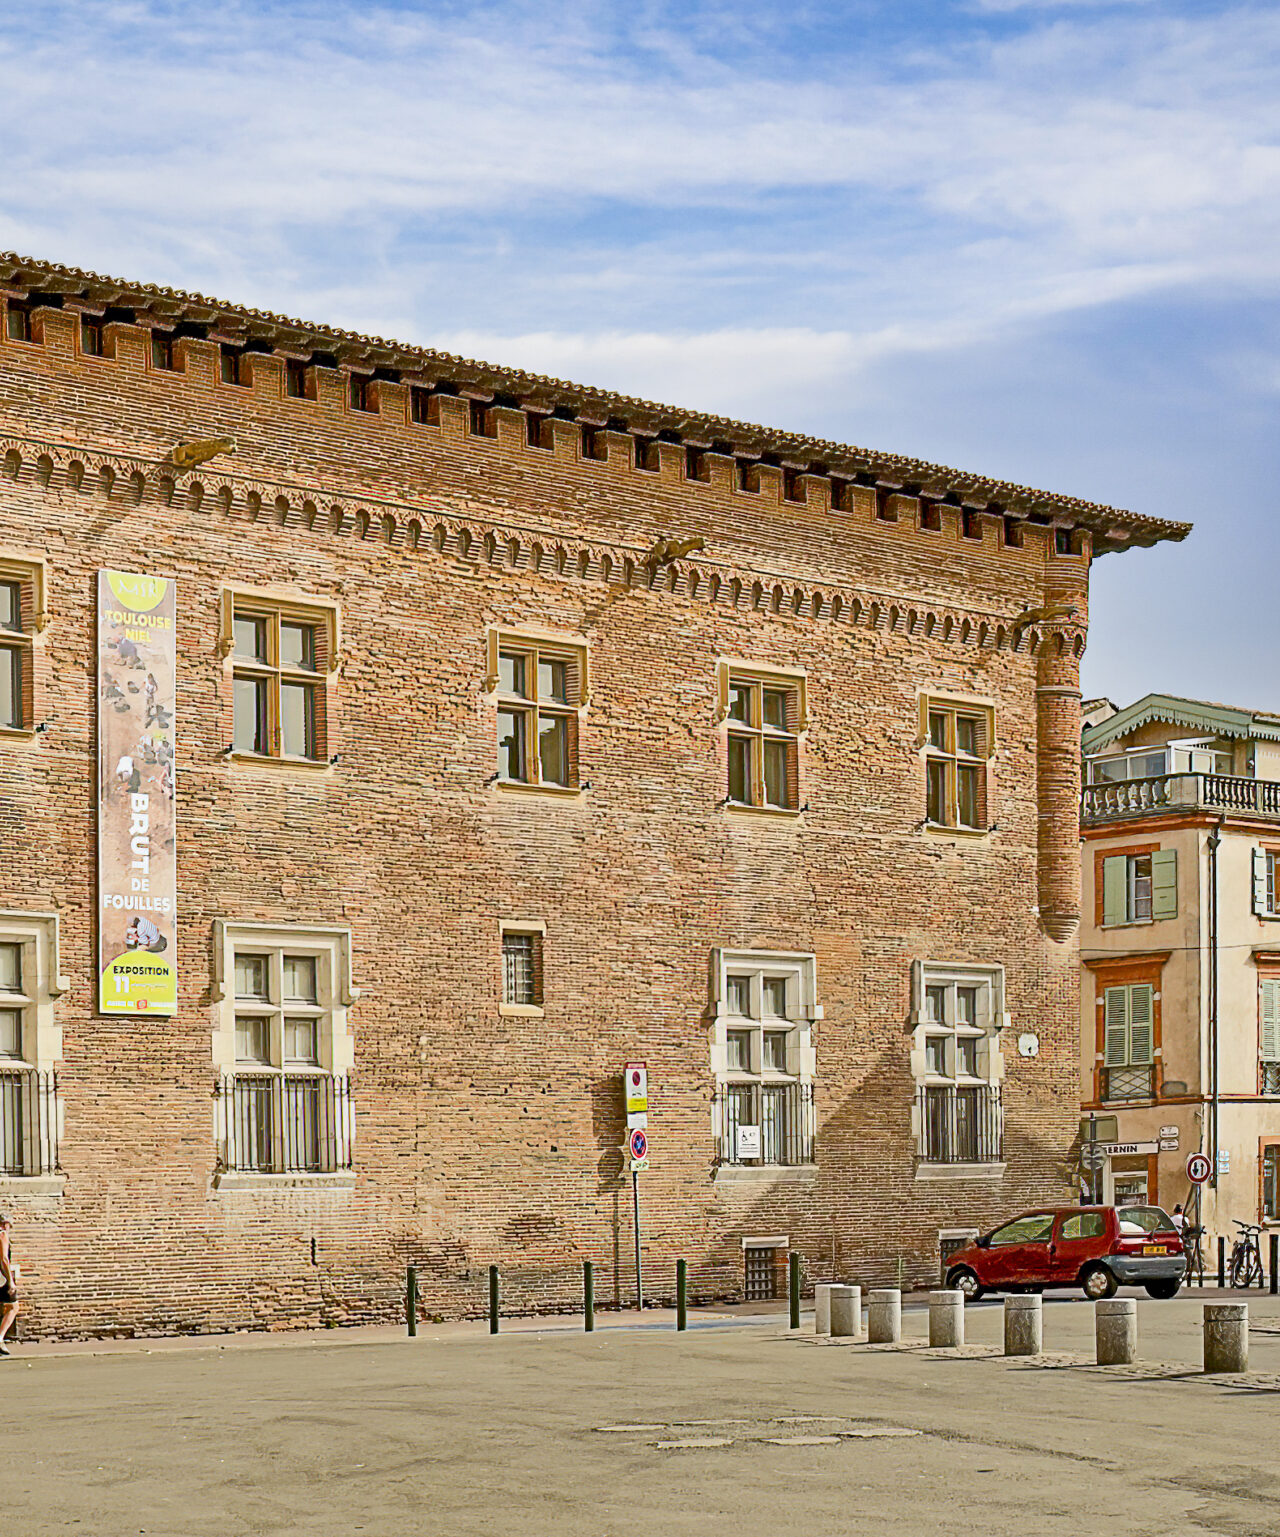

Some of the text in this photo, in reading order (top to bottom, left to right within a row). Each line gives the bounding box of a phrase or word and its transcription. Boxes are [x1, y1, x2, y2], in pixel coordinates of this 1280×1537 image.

[104, 610, 171, 629] TOULOUSE
[125, 628, 152, 643] NIEL
[129, 793, 149, 874] BRUT
[131, 878, 150, 892] DE
[103, 894, 171, 912] FOUILLES
[113, 966, 169, 976] EXPOSITION
[113, 976, 129, 993] 11
[1104, 1145, 1138, 1154] ERNIN
